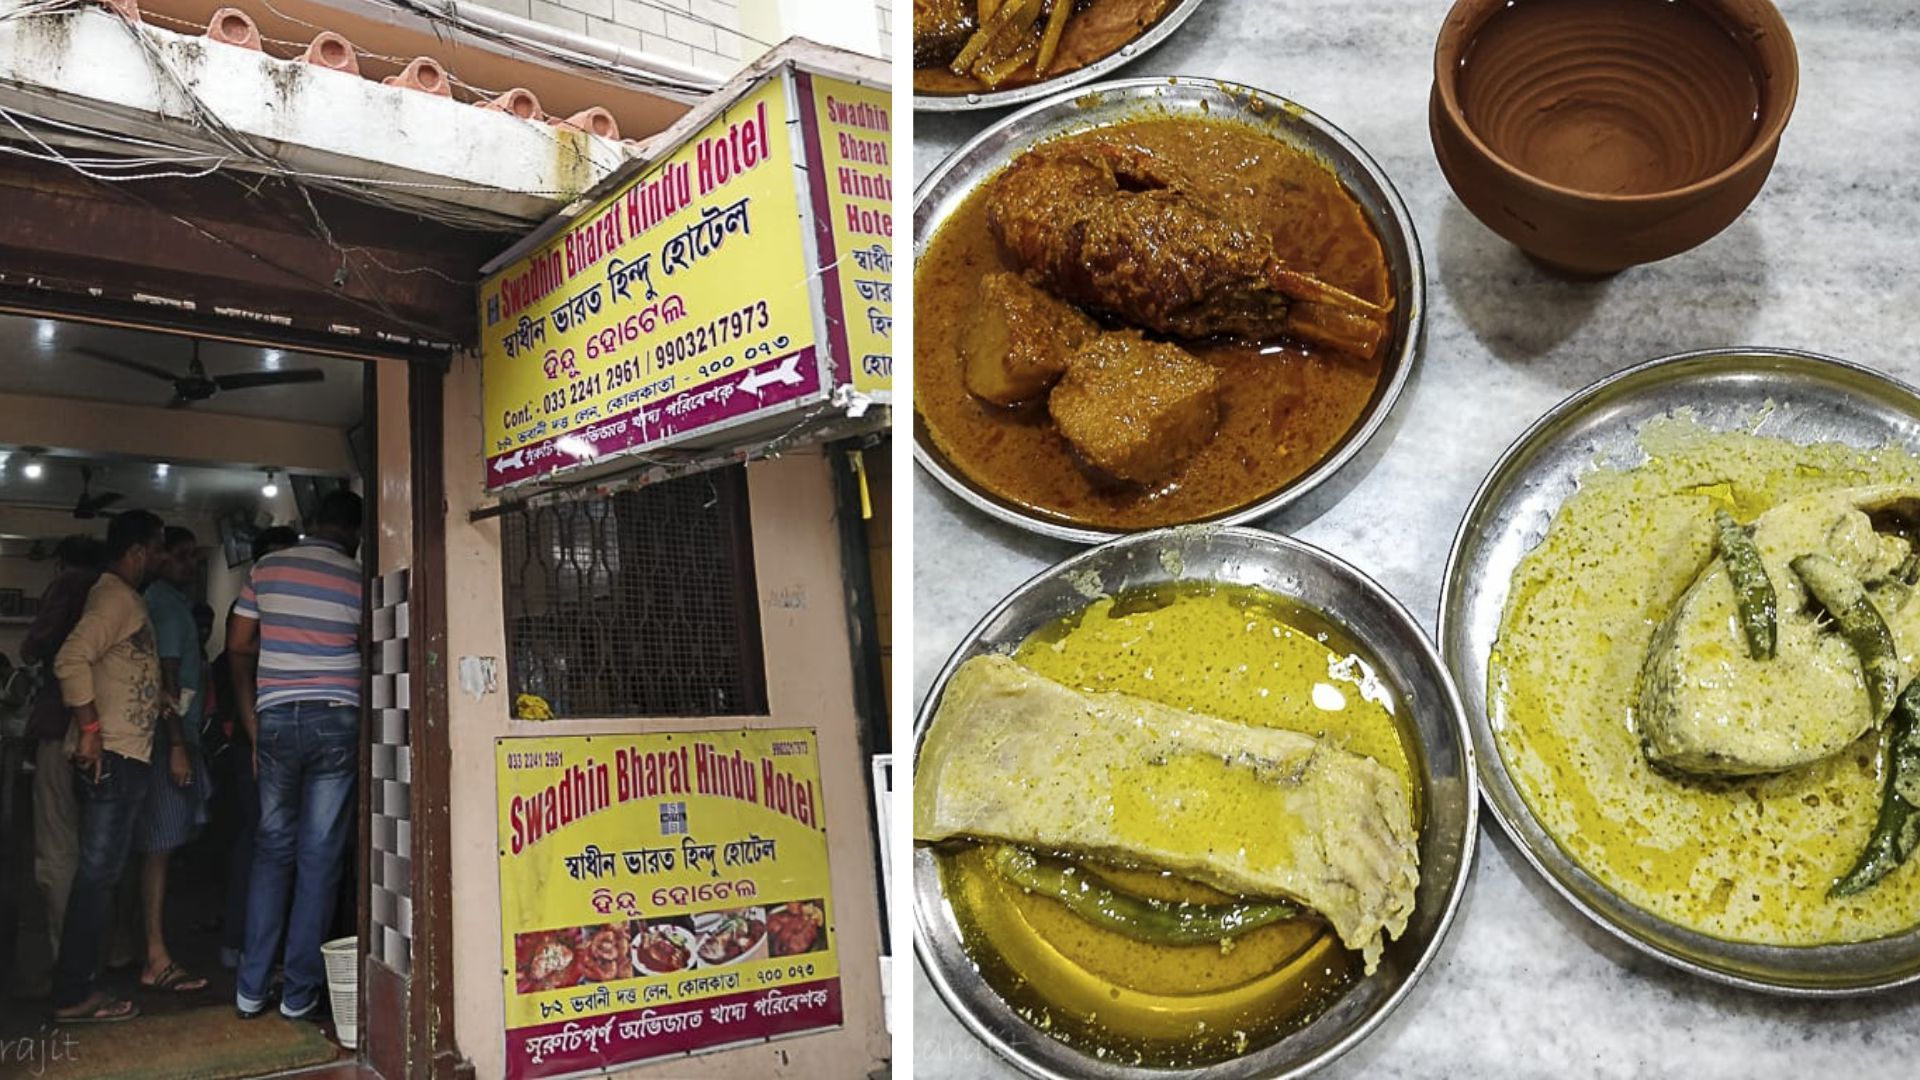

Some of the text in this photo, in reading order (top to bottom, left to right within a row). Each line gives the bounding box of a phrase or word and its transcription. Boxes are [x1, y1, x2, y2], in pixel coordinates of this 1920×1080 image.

[826, 94, 890, 133] Swadhin
[838, 131, 889, 167] Bharat
[501, 101, 770, 320] Swadhin Bharat Hindu Hotel
[502, 198, 750, 358] স্বাধীন ভারত হিন্দু হোটেল
[852, 244, 892, 273] স্বাধী
[586, 294, 687, 360] ହୋଟେଲ
[543, 388, 567, 414] 033
[570, 373, 602, 404] 2241
[606, 355, 640, 391] 2961
[655, 300, 770, 369] 9903217973
[607, 374, 676, 413] কোলকাতা
[698, 356, 735, 378] ৭০০
[745, 335, 790, 359] ০৭৩
[511, 758, 611, 856] Swadhin
[615, 745, 692, 804] Bharat
[694, 743, 758, 804] Hindu
[761, 757, 817, 830] Hotel
[565, 833, 777, 881] স্বাধীন ভারত হিন্দু হোটেল
[651, 878, 758, 907] ହୋଟେଲ
[540, 999, 565, 1019] ৮২
[570, 985, 611, 1013] ভবানী
[678, 972, 740, 998] কোলকাতা
[757, 969, 783, 984] ৭০০
[788, 963, 816, 978] ০৭৩
[619, 1008, 704, 1041] অভিজাত
[753, 989, 829, 1018] পরিবেশক
